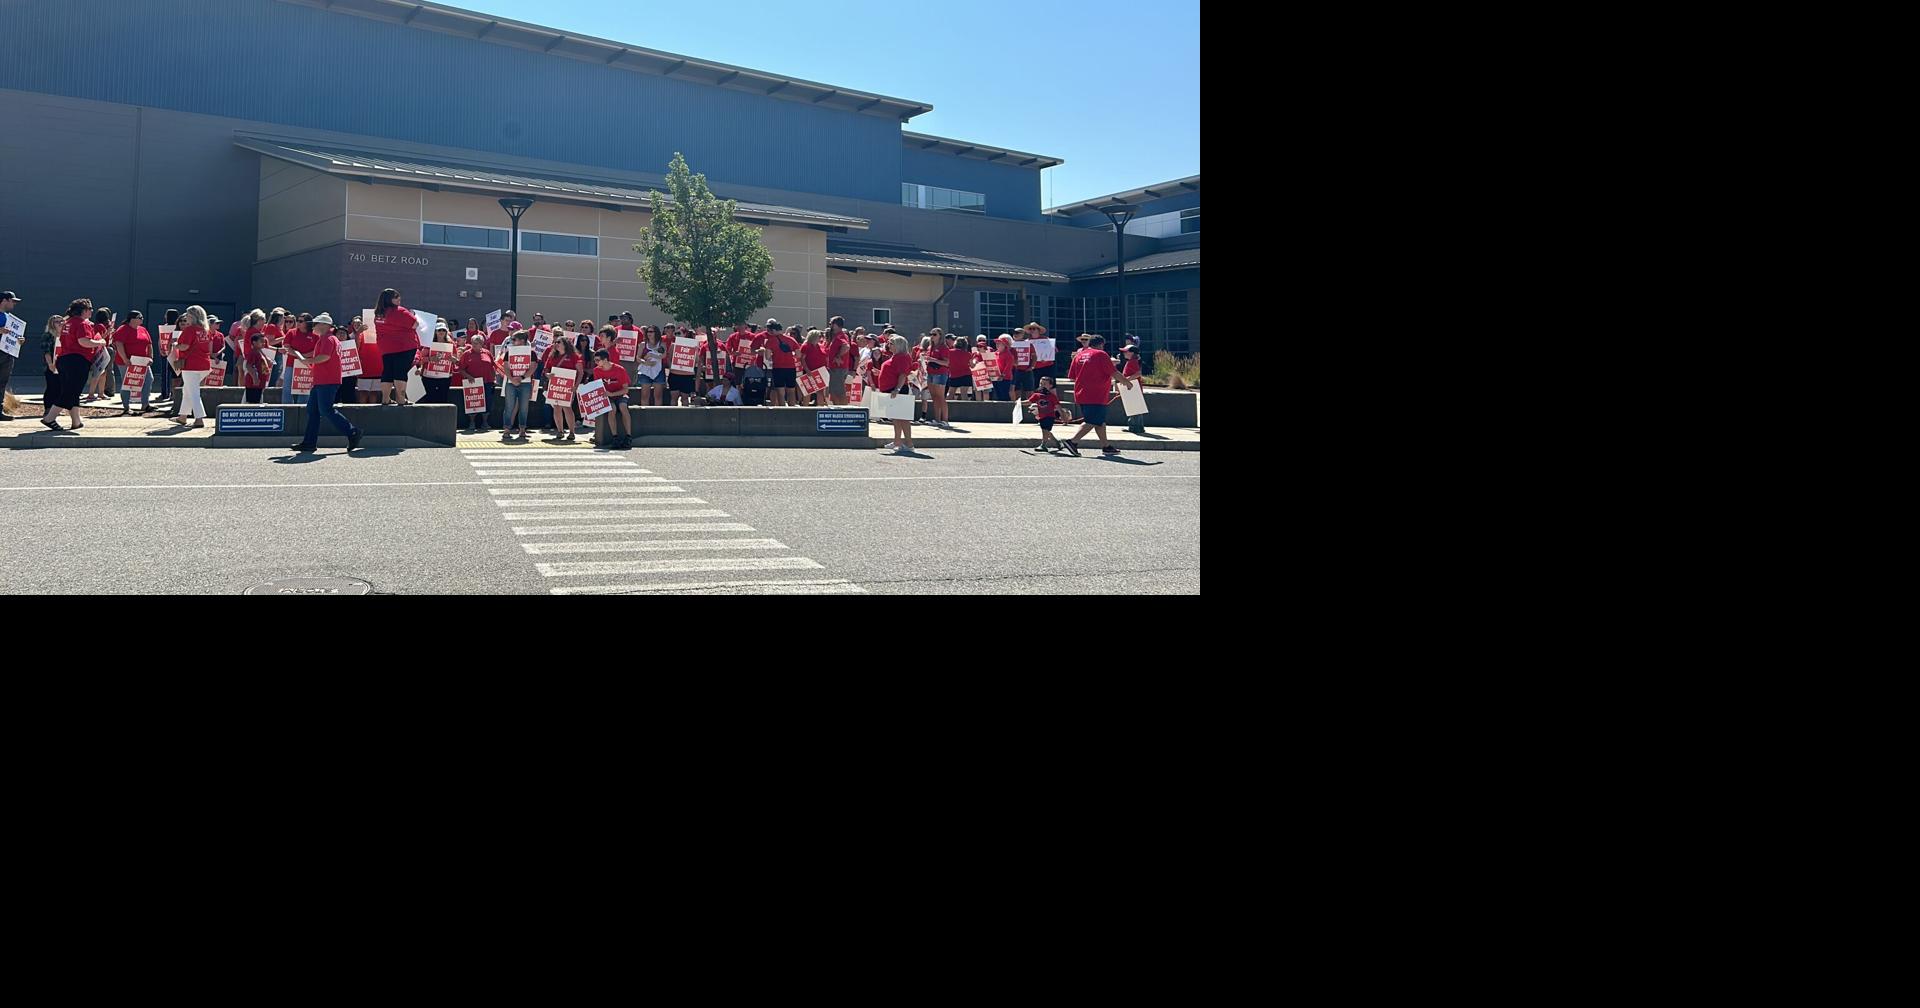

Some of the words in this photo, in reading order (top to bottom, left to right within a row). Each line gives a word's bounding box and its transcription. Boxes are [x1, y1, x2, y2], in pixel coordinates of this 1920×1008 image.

[349, 253, 366, 262] 740
[371, 254, 397, 264] BETZ
[401, 256, 429, 266] ROAD
[588, 390, 599, 398] Fair
[590, 401, 604, 412] Now!
